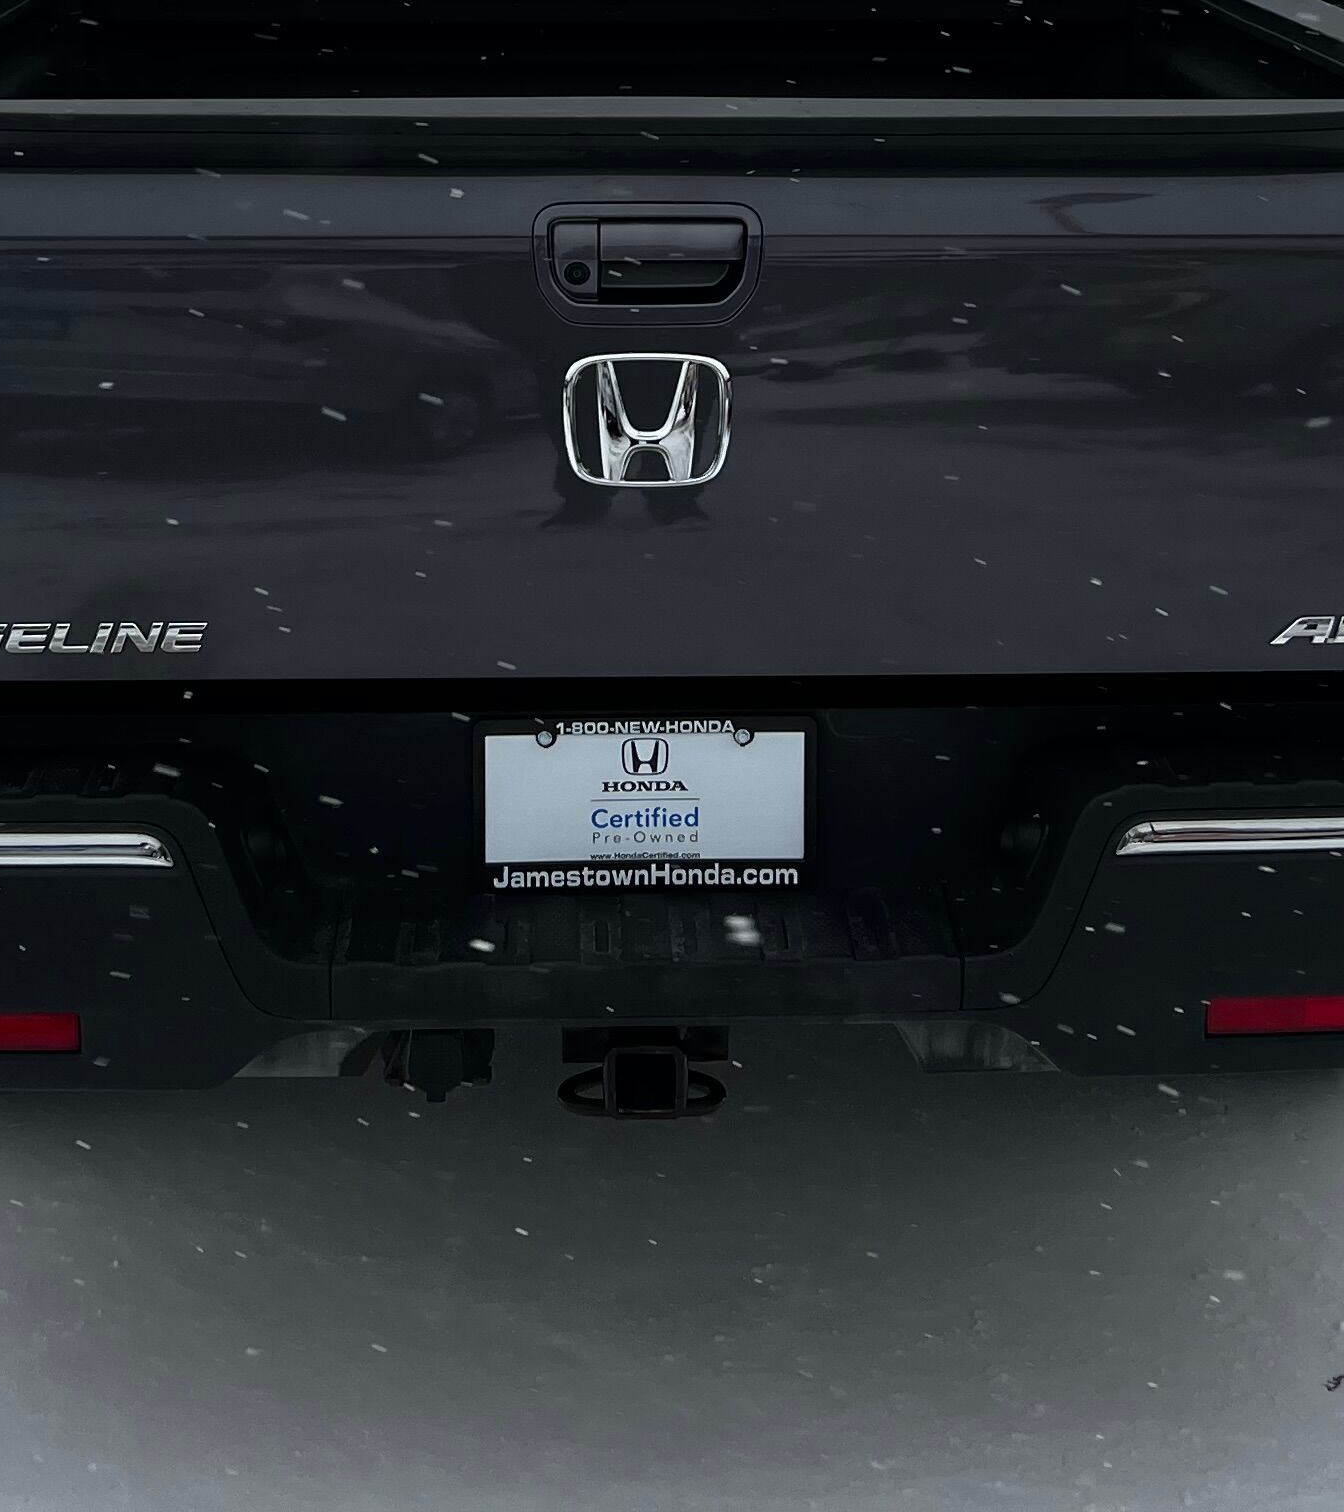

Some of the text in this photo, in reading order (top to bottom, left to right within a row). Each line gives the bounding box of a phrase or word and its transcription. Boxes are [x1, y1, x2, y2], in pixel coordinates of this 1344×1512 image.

[555, 719, 736, 735] 1-800-NEW-HONDA
[601, 780, 689, 793] HONDA
[590, 806, 700, 829] Certified
[592, 830, 699, 844] Pre-Owned
[493, 862, 799, 889] JamestownHonda.com
